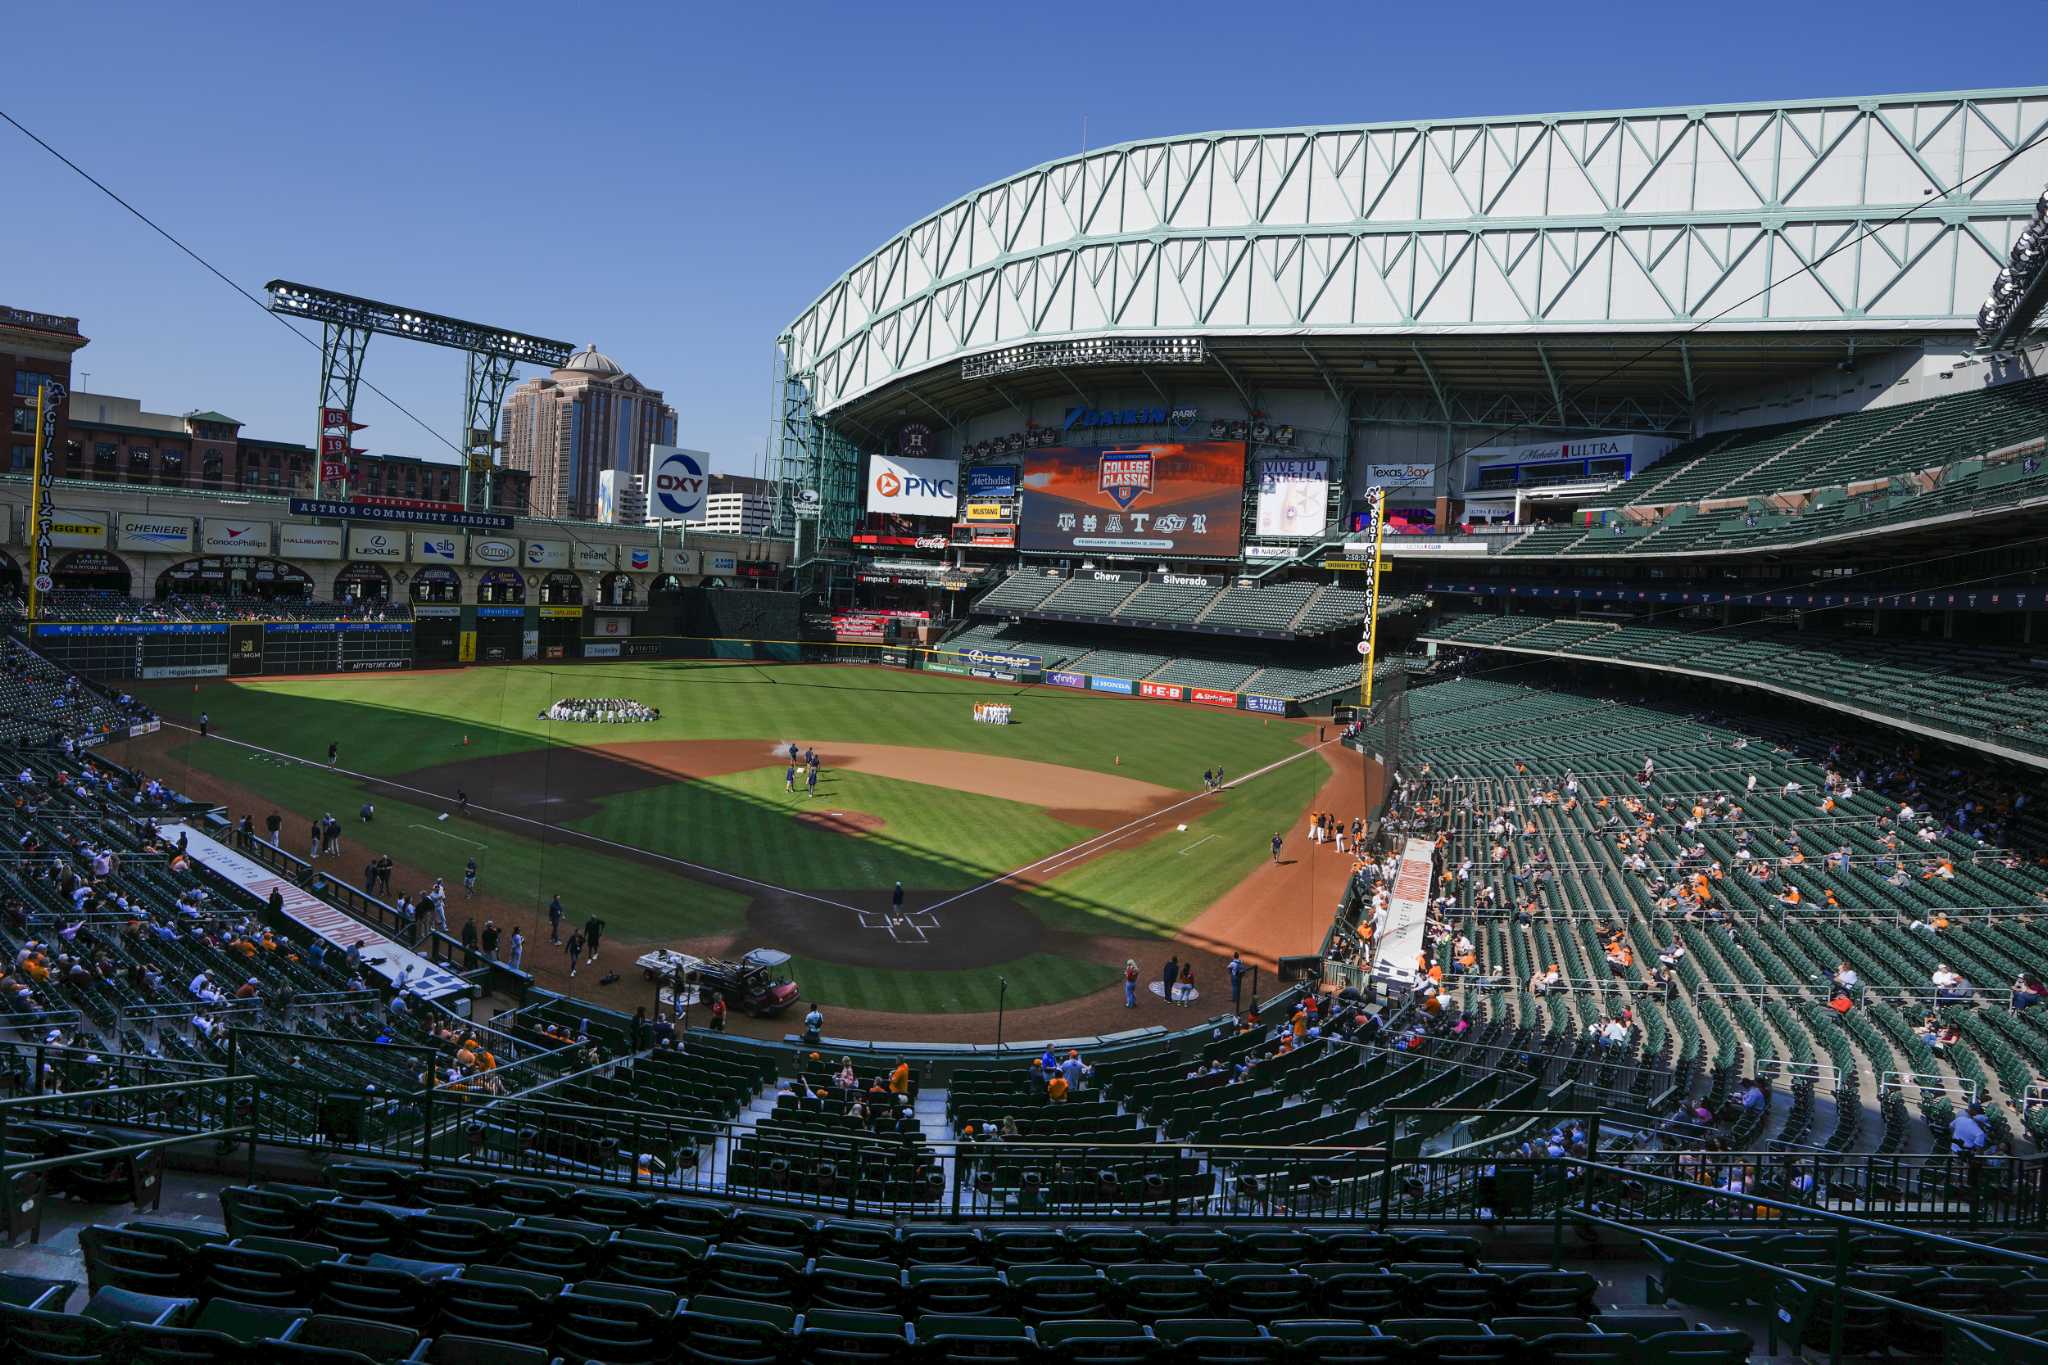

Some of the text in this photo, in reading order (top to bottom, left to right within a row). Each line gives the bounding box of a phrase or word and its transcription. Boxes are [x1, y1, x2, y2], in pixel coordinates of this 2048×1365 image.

[328, 413, 344, 424] 05
[1171, 409, 1197, 419] PARK
[327, 439, 343, 450] 19
[1580, 442, 1619, 457] ULTRA
[326, 465, 340, 476] 21
[1103, 461, 1150, 474] COLLEGE
[1265, 460, 1316, 472] VIVE TU
[1263, 472, 1323, 482] ESTRELLA
[1372, 466, 1429, 480] Texas Bay
[656, 474, 703, 493] OXY
[972, 475, 1011, 486] Methodist
[1103, 473, 1149, 488] CLASSIC
[904, 477, 954, 498] PNC
[300, 503, 506, 526] ASTROS COMMUNITY LEADERS
[125, 523, 188, 535] CHENIERE
[1369, 509, 1379, 543] ROOT
[38, 519, 50, 575] FAIR
[207, 537, 268, 548] ConocoPhillips
[436, 539, 455, 552] slb
[914, 536, 945, 549] Coca-Cola
[355, 547, 400, 556] LEXUS
[580, 551, 608, 560] reliant
[863, 576, 890, 584] impact
[1094, 572, 1120, 584] Chevy
[1163, 575, 1207, 586] Silverado
[1362, 589, 1374, 641] CHIKIN
[168, 667, 218, 677] Higginbotham
[1053, 673, 1077, 685] xfinity
[1100, 681, 1131, 690] HONDA
